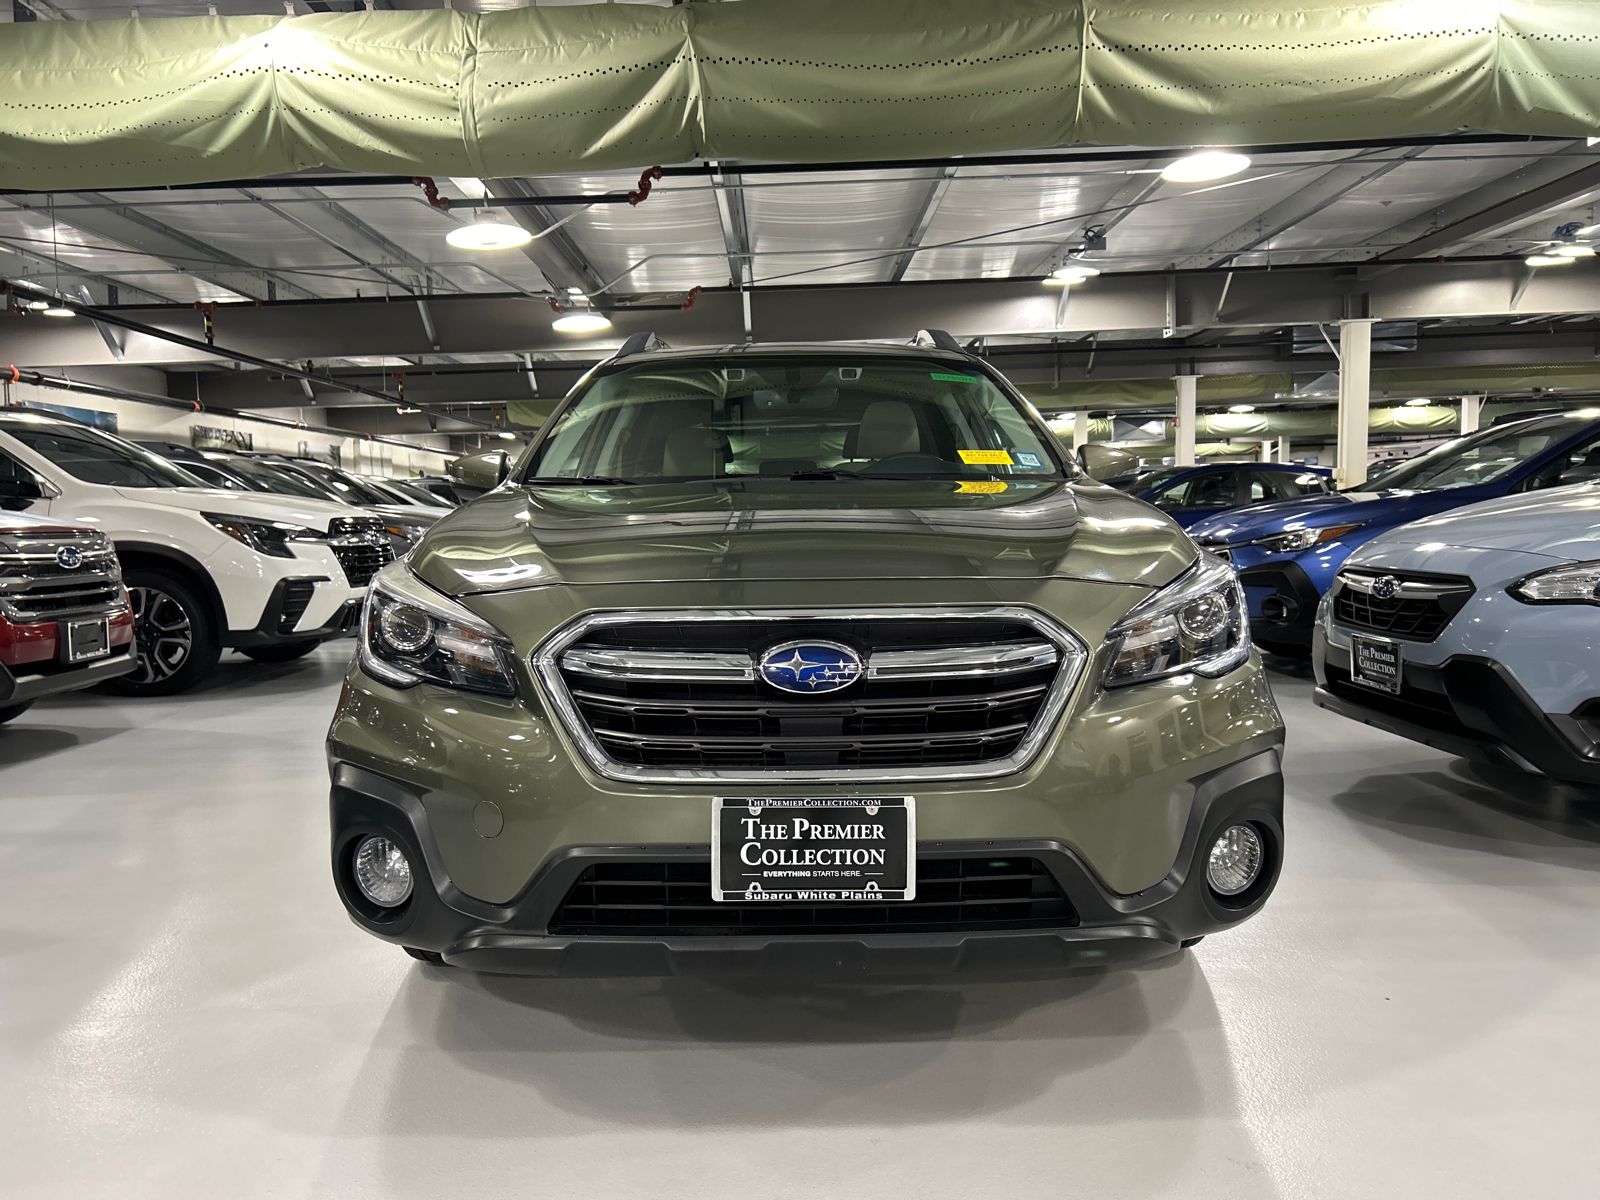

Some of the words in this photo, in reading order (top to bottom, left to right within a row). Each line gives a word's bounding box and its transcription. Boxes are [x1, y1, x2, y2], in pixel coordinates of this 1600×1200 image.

[1358, 645, 1370, 658] THE
[1370, 647, 1395, 663] PREMIER
[1358, 656, 1396, 675] COLLECTION
[740, 818, 788, 840] THE
[792, 818, 886, 840] PREMIER
[740, 841, 886, 866] COLLECTION
[744, 892, 792, 900] Subaru
[796, 892, 836, 900] White
[841, 892, 883, 900] Plains
